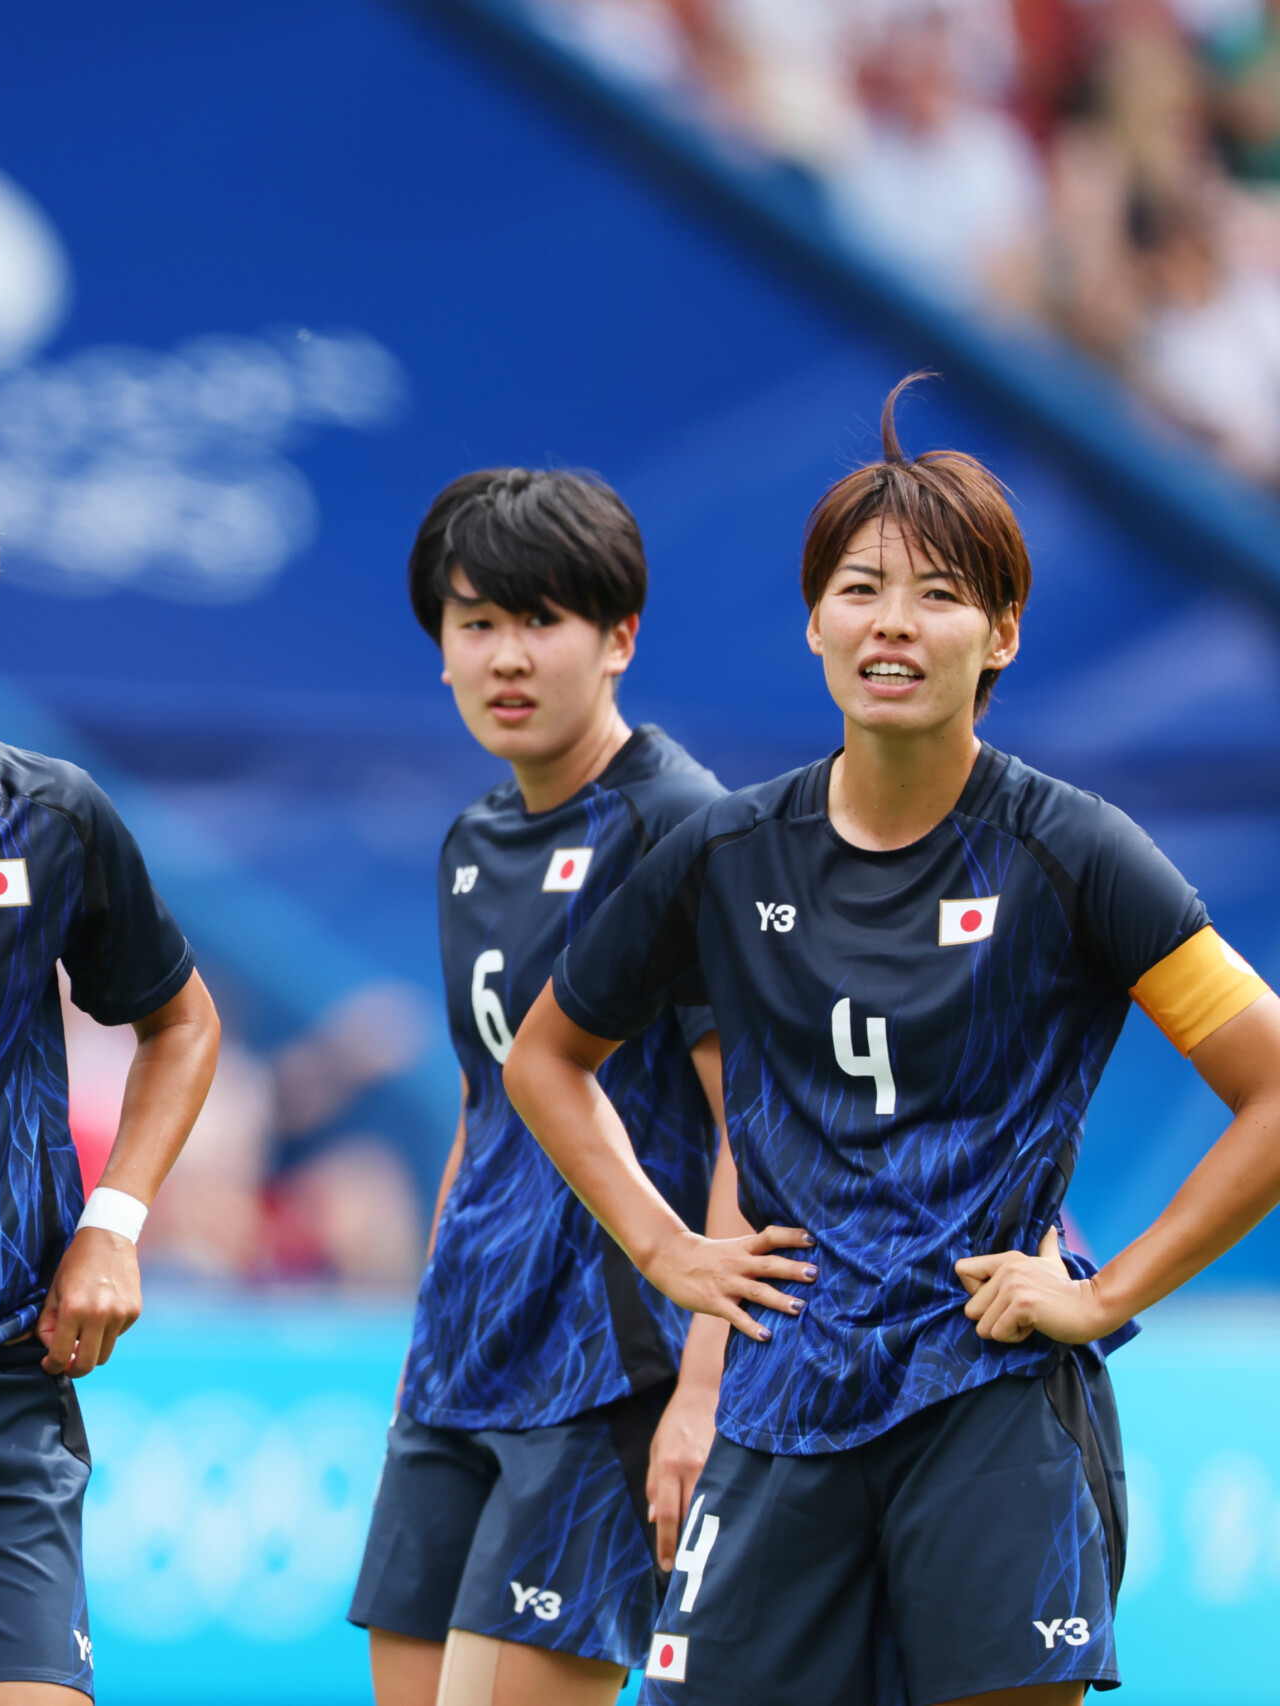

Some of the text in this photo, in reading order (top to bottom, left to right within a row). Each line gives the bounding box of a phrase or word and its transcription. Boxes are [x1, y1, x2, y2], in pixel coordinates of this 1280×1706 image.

[755, 901, 797, 933] Y-3
[471, 949, 515, 1065] 6
[831, 997, 896, 1115] 4
[674, 1493, 720, 1613] 4
[510, 1581, 562, 1621] Y-3
[72, 1629, 94, 1670] Y-
[1032, 1617, 1091, 1649] Y-3
